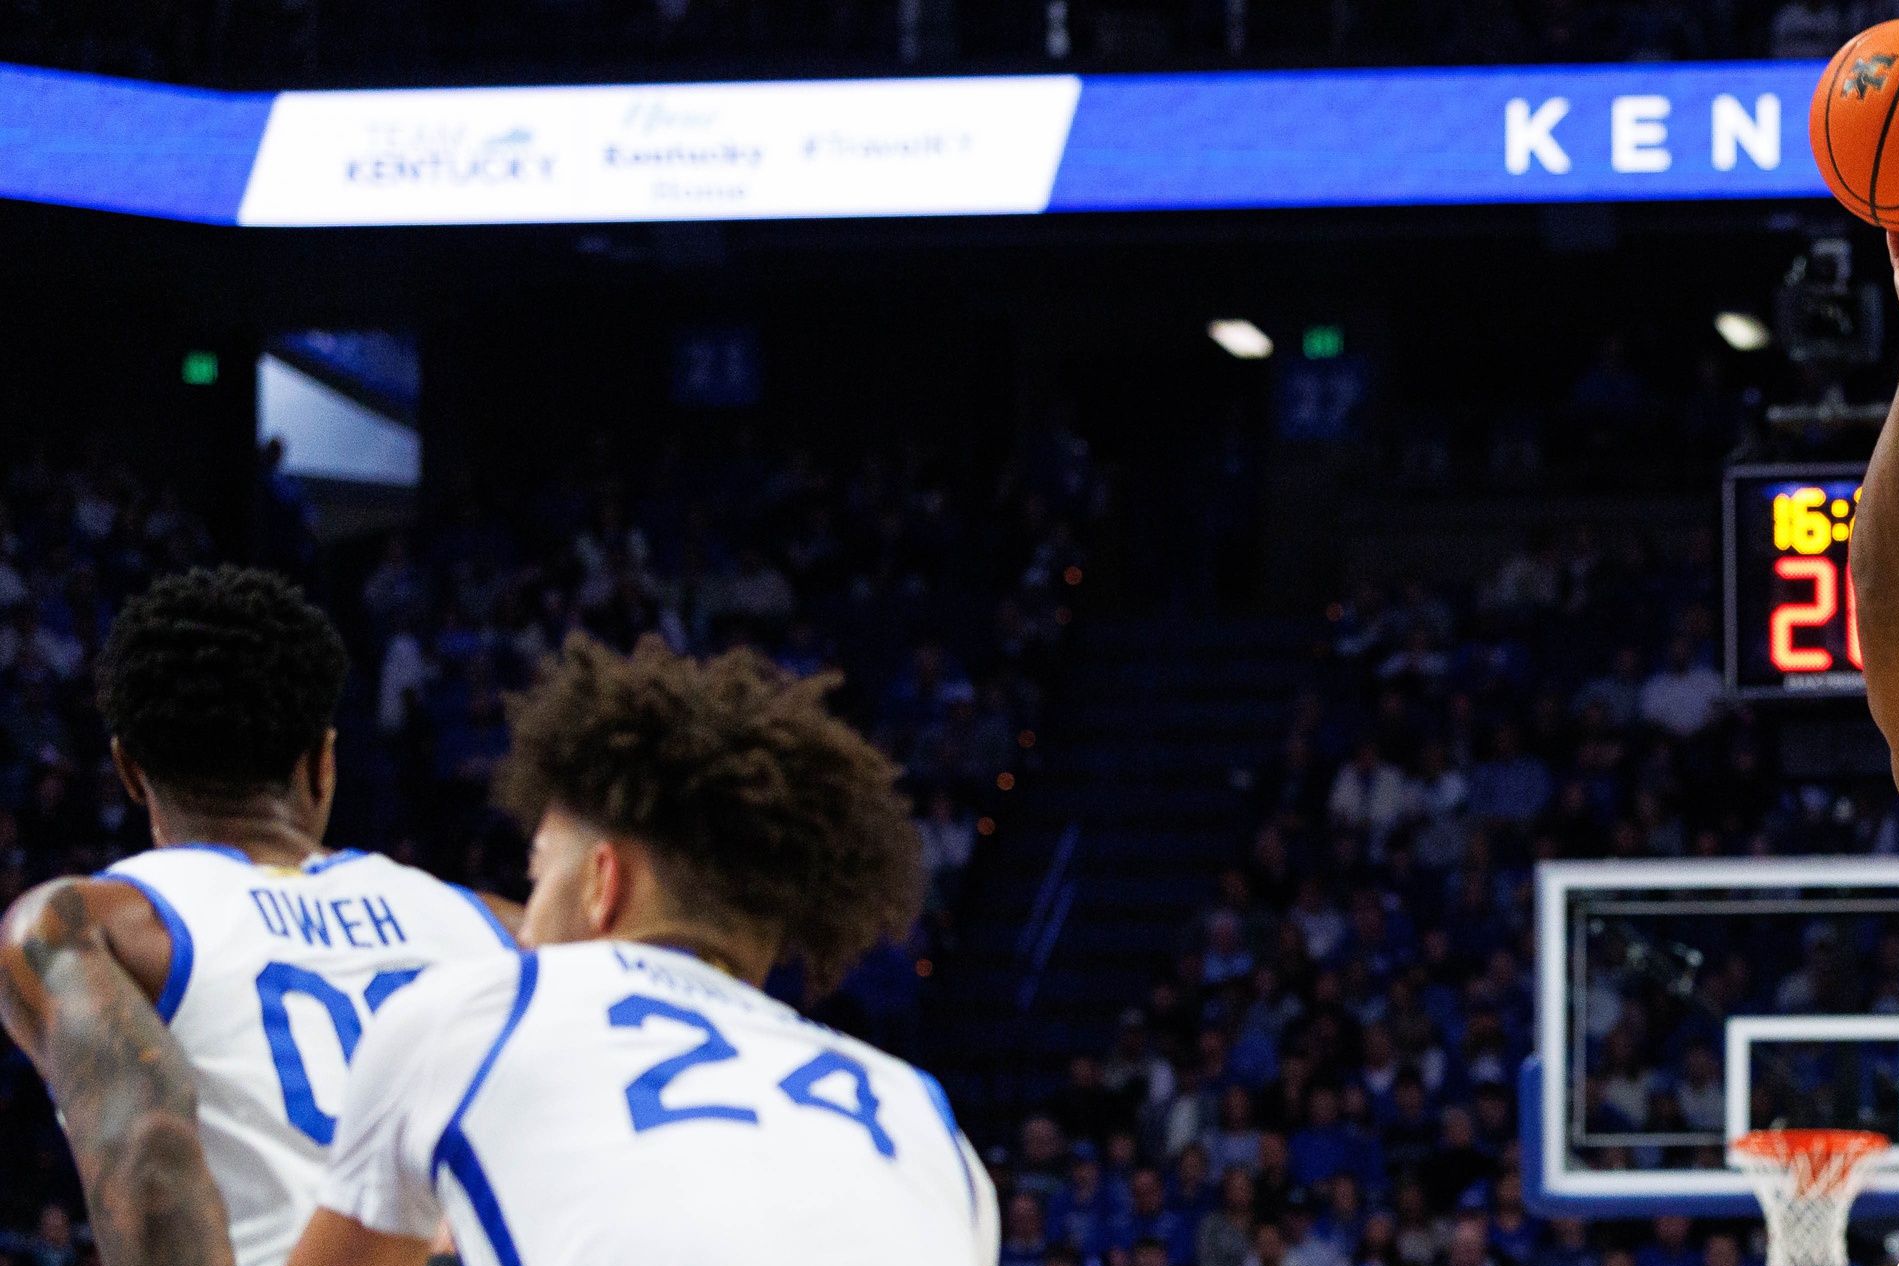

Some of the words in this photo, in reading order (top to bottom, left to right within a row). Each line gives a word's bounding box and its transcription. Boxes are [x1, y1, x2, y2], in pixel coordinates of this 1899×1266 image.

[343, 152, 557, 186] KENTUCKY
[603, 143, 765, 171] Kentucky
[1773, 487, 1863, 555] 16:
[1769, 556, 1863, 672] 2
[249, 887, 407, 948] OWEH
[607, 993, 896, 1160] 24
